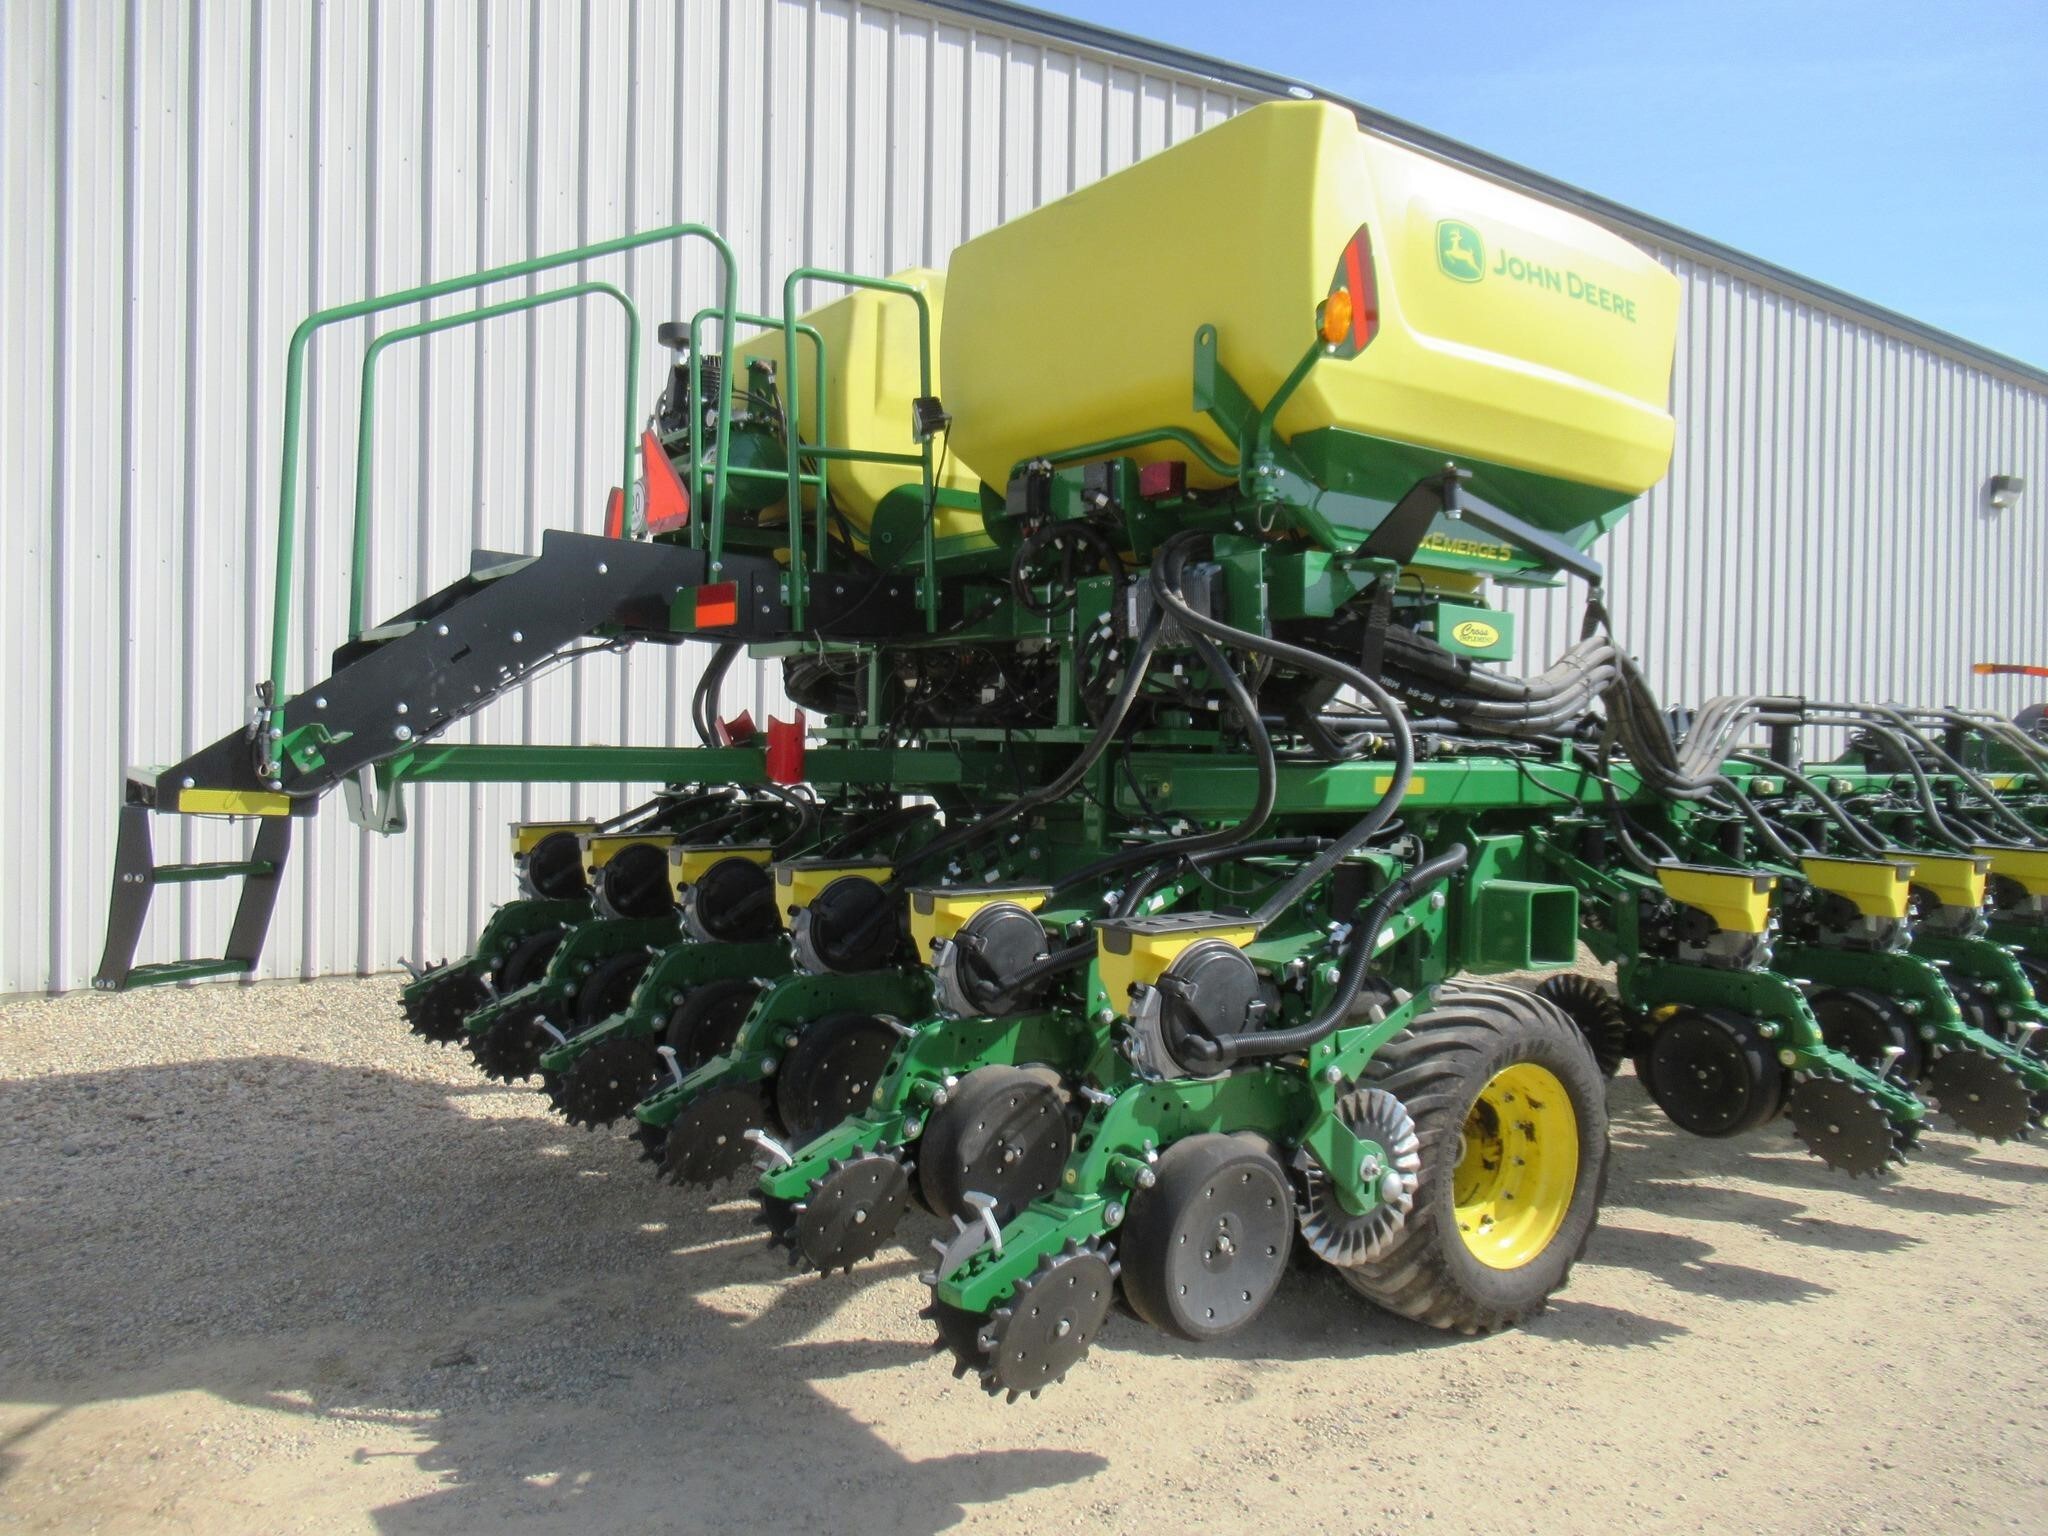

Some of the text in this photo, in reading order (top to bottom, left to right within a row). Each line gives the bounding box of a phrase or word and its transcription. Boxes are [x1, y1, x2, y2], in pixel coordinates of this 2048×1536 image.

[1493, 248, 1637, 323] JOHN DEERE
[1499, 543, 1513, 561] 5
[1461, 623, 1488, 636] Cross
